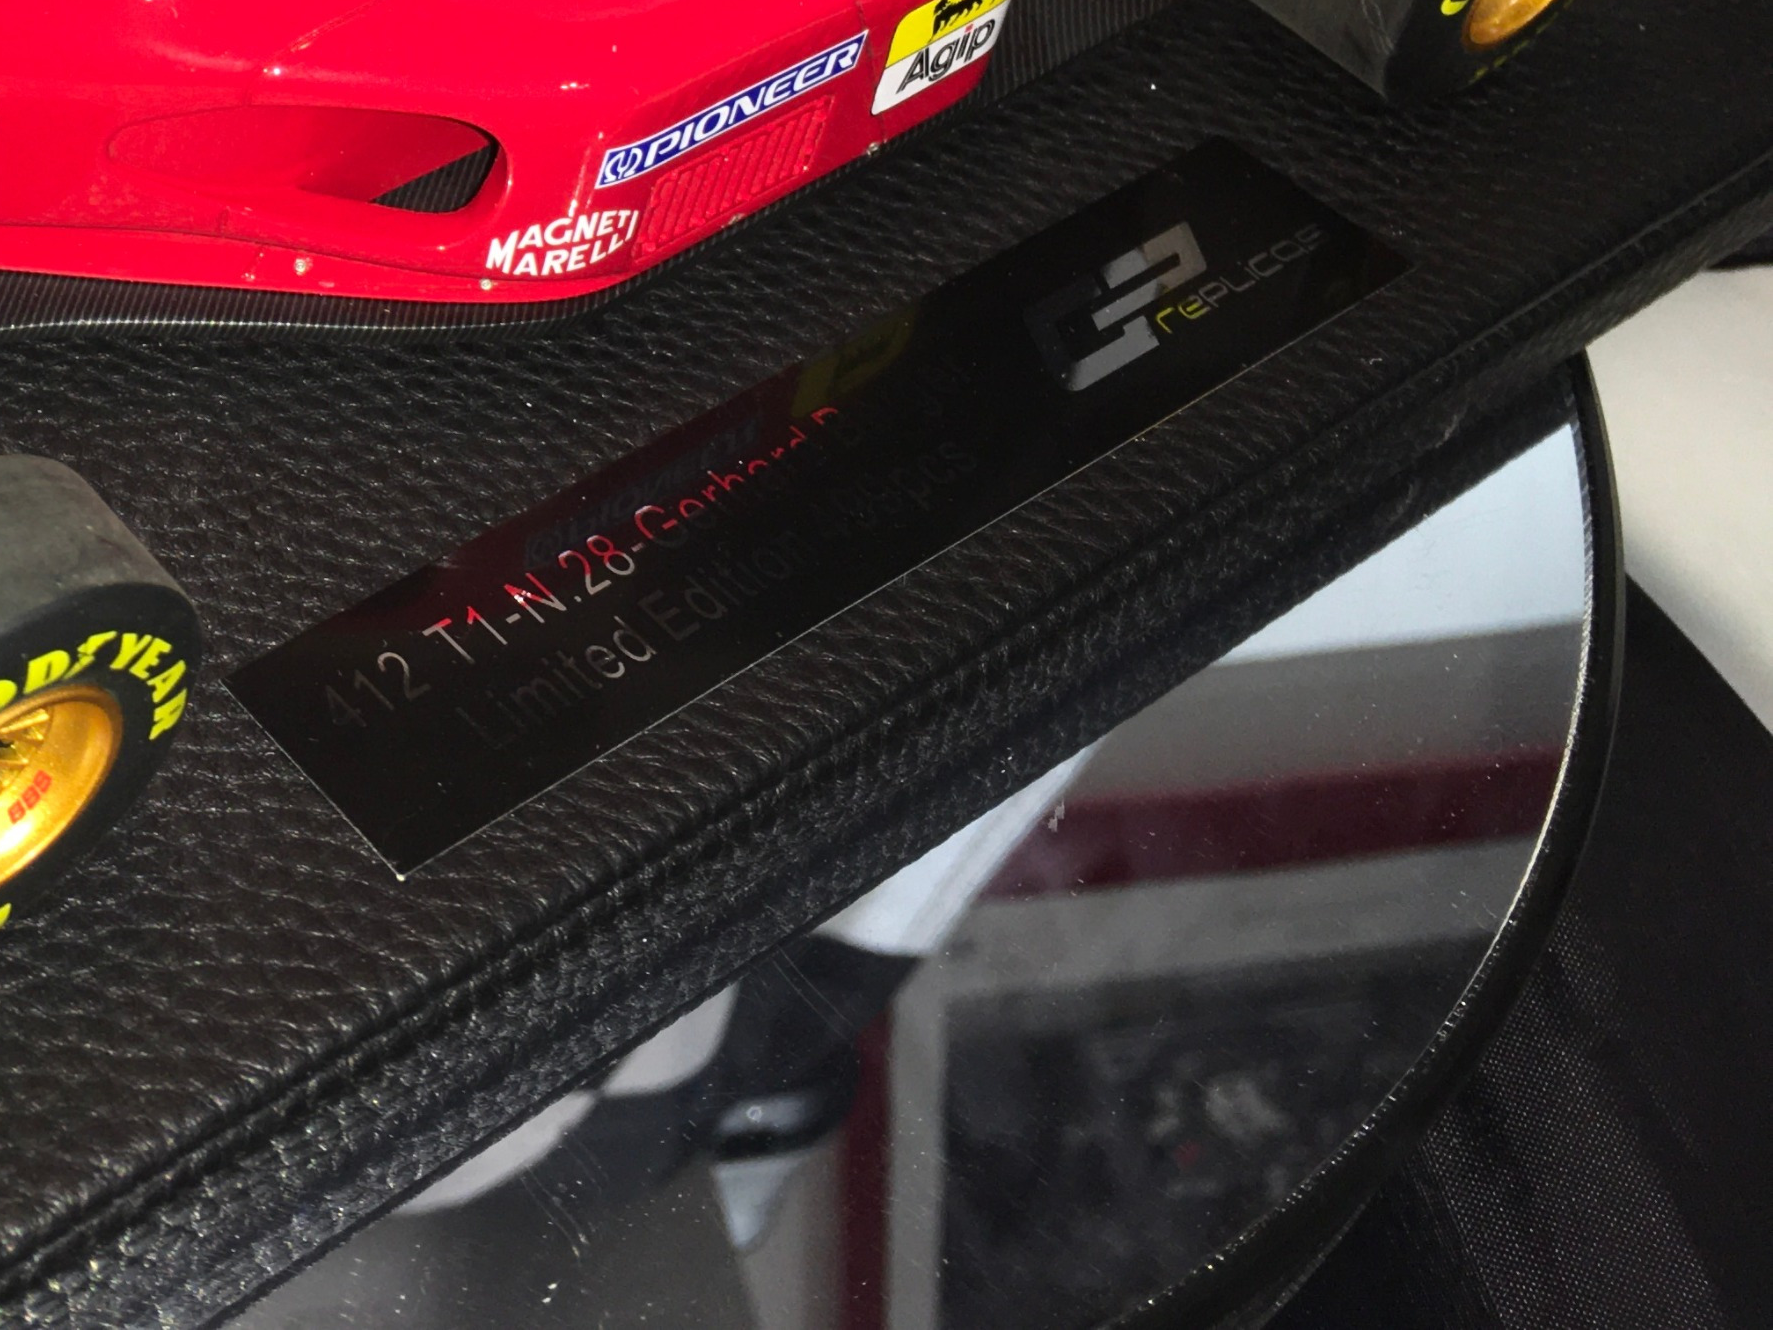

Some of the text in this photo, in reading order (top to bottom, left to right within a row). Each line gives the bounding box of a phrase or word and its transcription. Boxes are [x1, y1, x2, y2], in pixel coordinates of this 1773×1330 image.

[895, 16, 996, 94] Agip
[643, 36, 864, 166] PIONEER
[325, 650, 432, 728] 412
